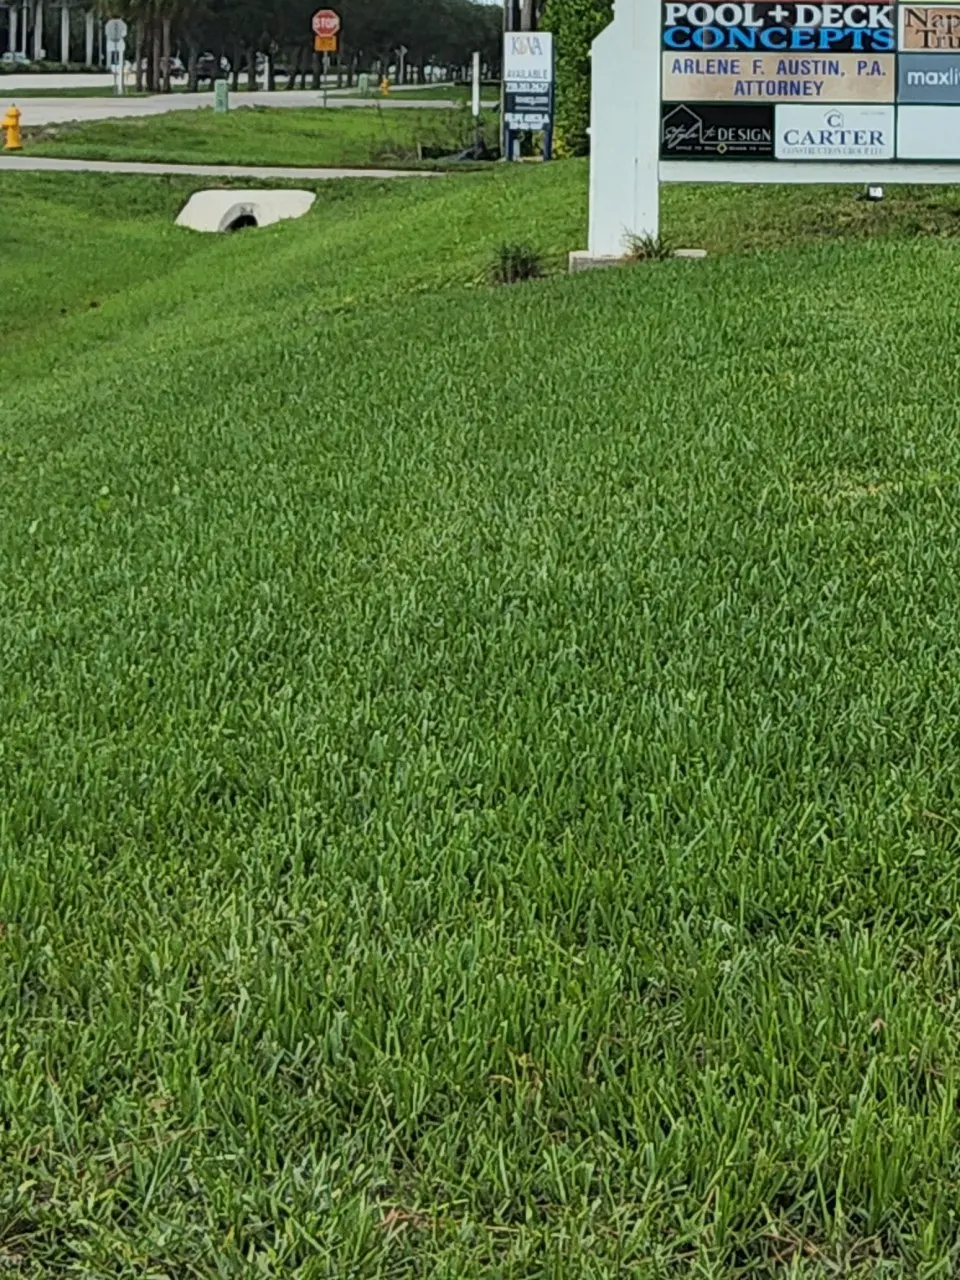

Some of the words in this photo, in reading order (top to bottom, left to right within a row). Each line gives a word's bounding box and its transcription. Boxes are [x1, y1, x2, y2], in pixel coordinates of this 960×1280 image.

[665, 3, 765, 27] POOL
[793, 3, 894, 28] DECK
[664, 27, 895, 51] CONCEPTS
[671, 59, 740, 75] ARLENE
[753, 59, 765, 75] F.
[776, 59, 845, 78] AUSTIN,
[857, 60, 886, 76] P.A.
[733, 80, 825, 97] ATTORNEY
[718, 128, 771, 141] DESIGN
[783, 129, 886, 146] CARTER
